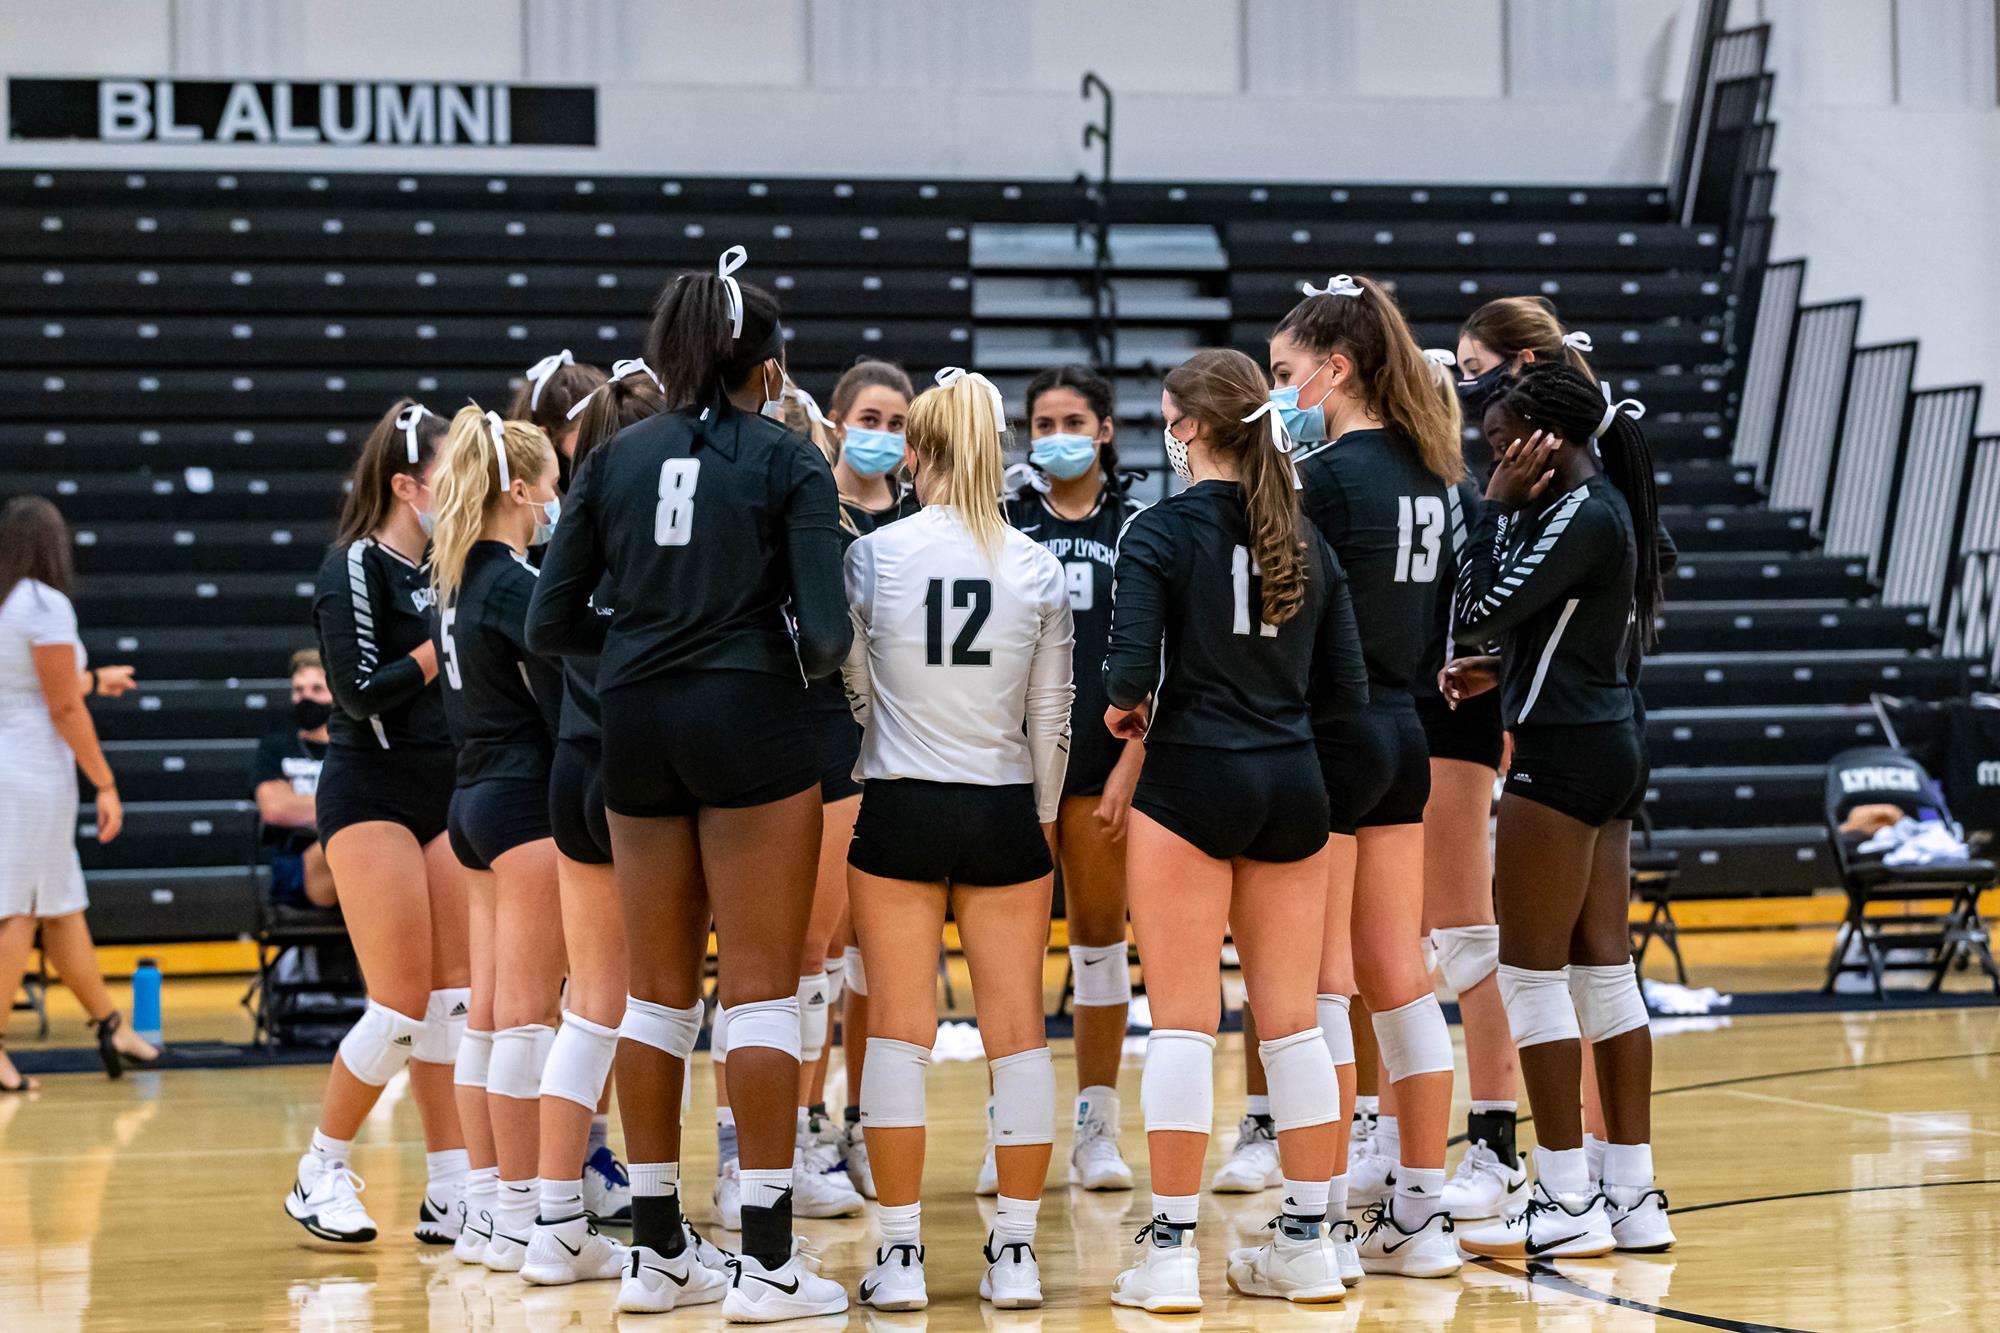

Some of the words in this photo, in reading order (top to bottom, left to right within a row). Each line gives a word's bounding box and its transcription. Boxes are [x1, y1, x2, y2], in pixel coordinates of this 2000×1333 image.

[99, 80, 204, 142] BL
[214, 80, 511, 144] ALUMNI
[655, 457, 700, 546] 8
[1039, 539, 1073, 558] HOP
[1074, 538, 1115, 567] LYNCH
[1394, 495, 1445, 582] 13
[1064, 562, 1094, 611] 9
[923, 577, 993, 667] 12
[1839, 766, 1921, 794] LYNCH
